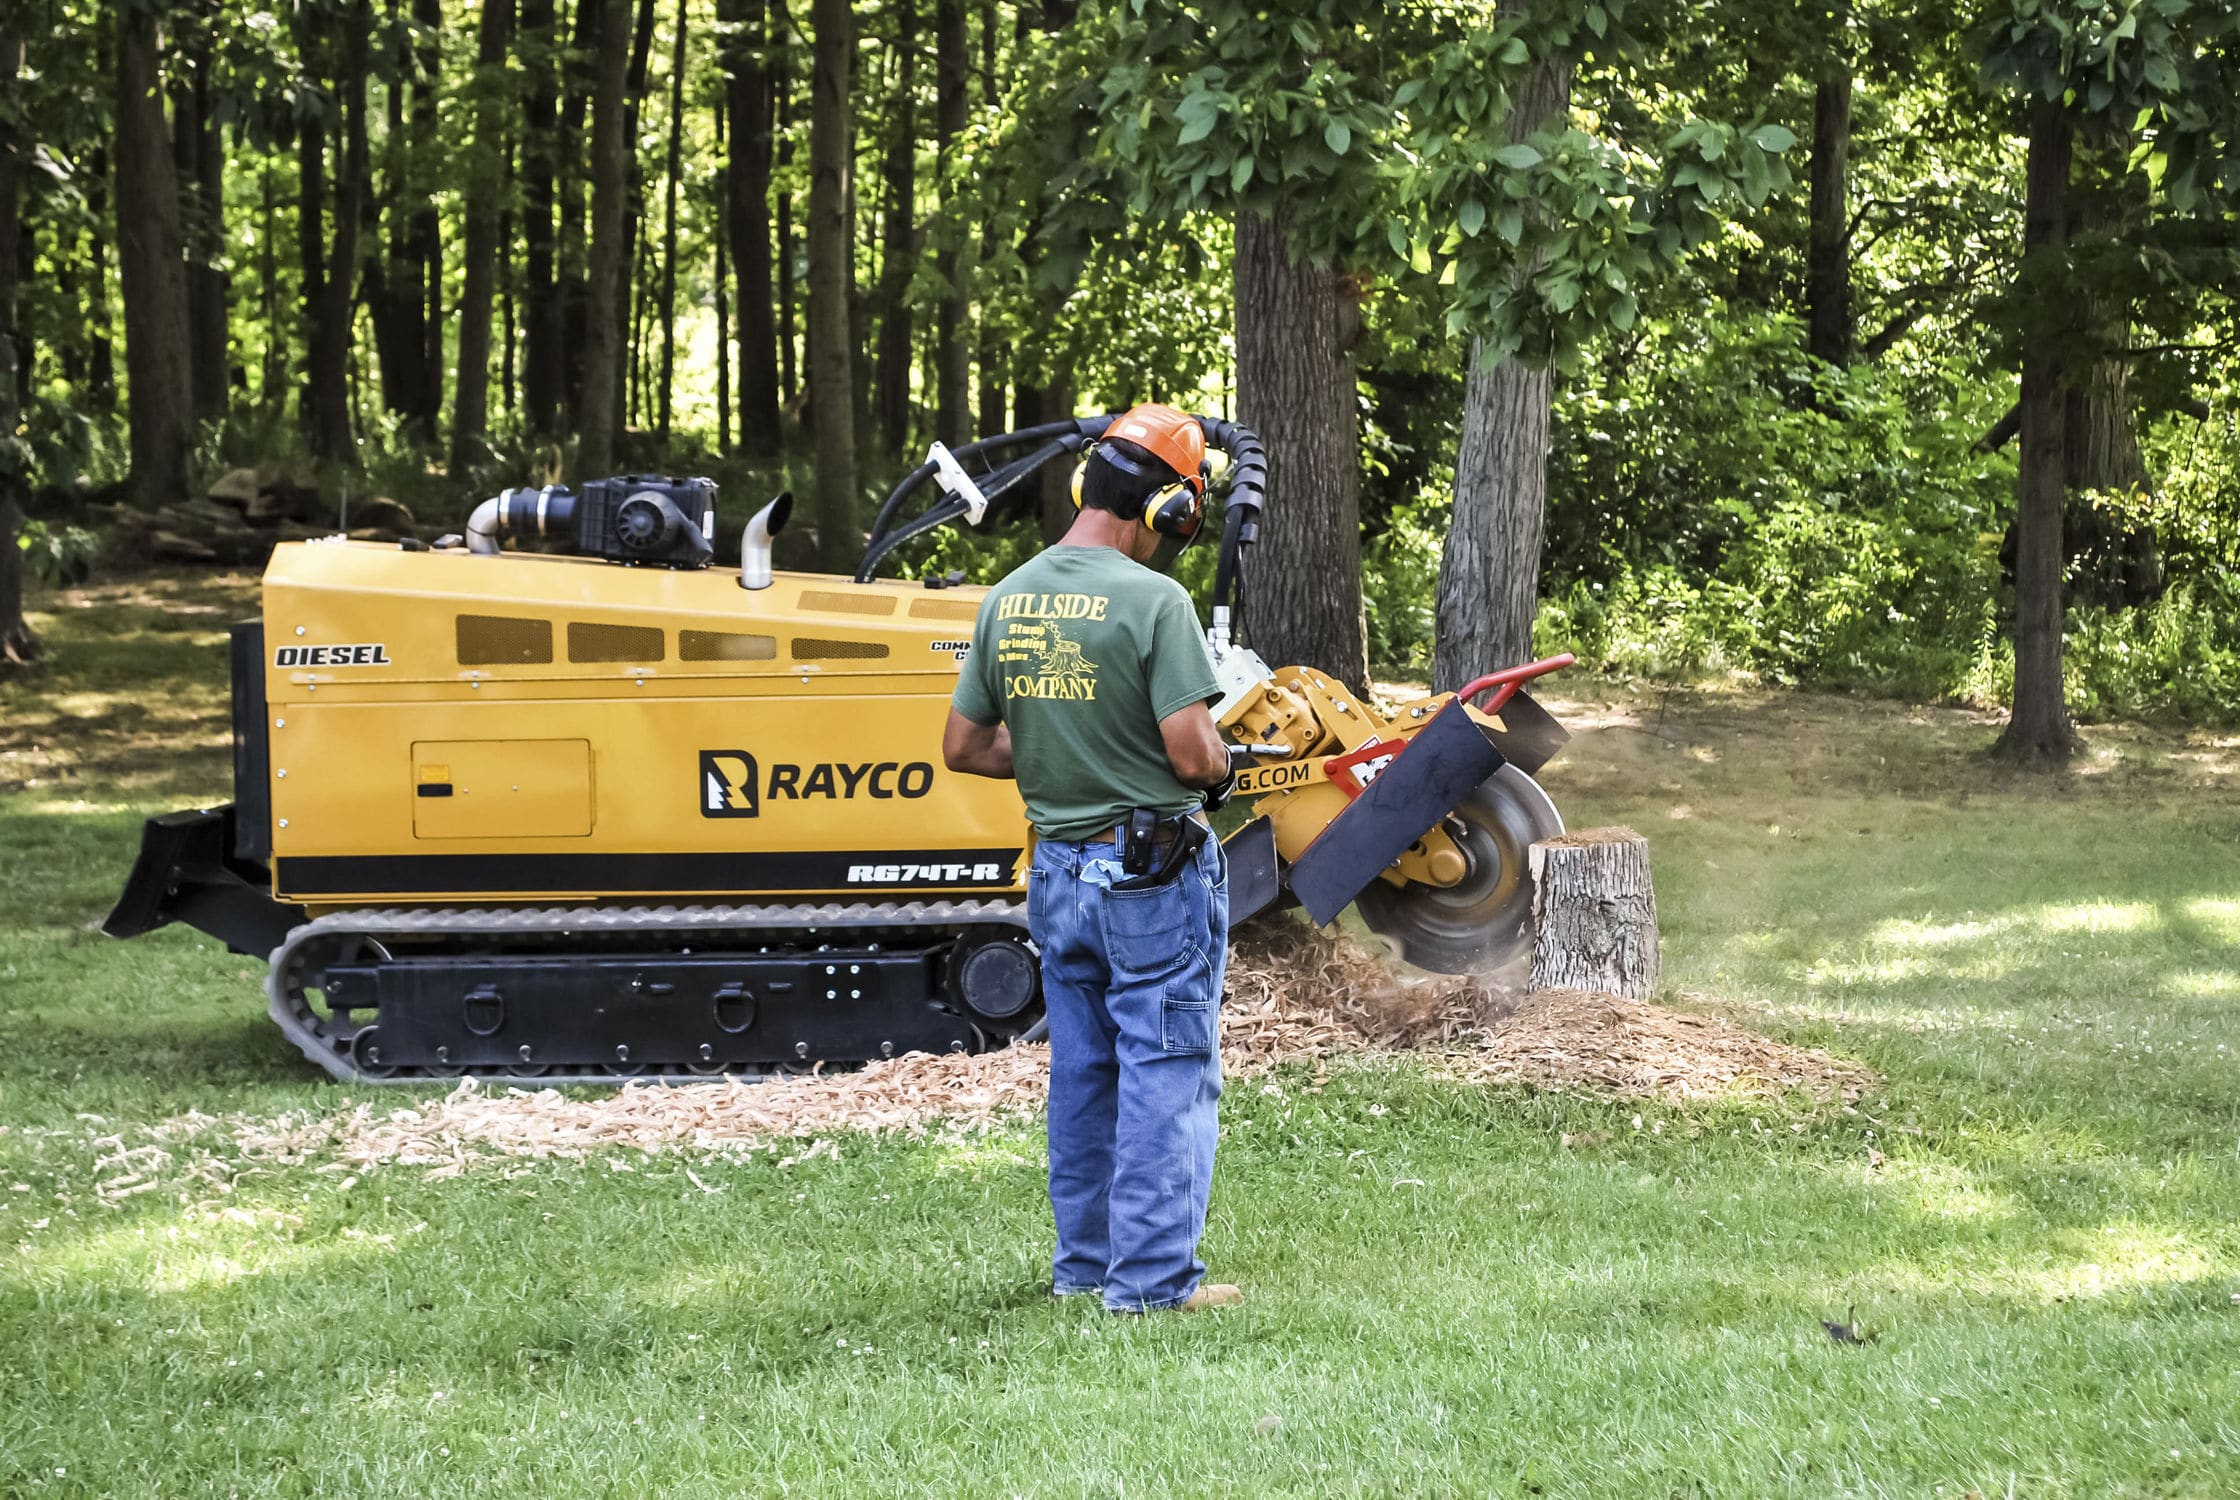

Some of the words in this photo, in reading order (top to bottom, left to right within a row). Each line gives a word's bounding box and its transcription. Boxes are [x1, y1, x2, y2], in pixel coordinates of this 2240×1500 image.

[997, 593, 1109, 622] HILLSIDE
[276, 646, 389, 666] DIESEL
[1005, 675, 1097, 700] COMPANY
[767, 762, 934, 799] RAYCO
[1234, 763, 1310, 792] G.COM
[847, 863, 1000, 882] RG74T-R
